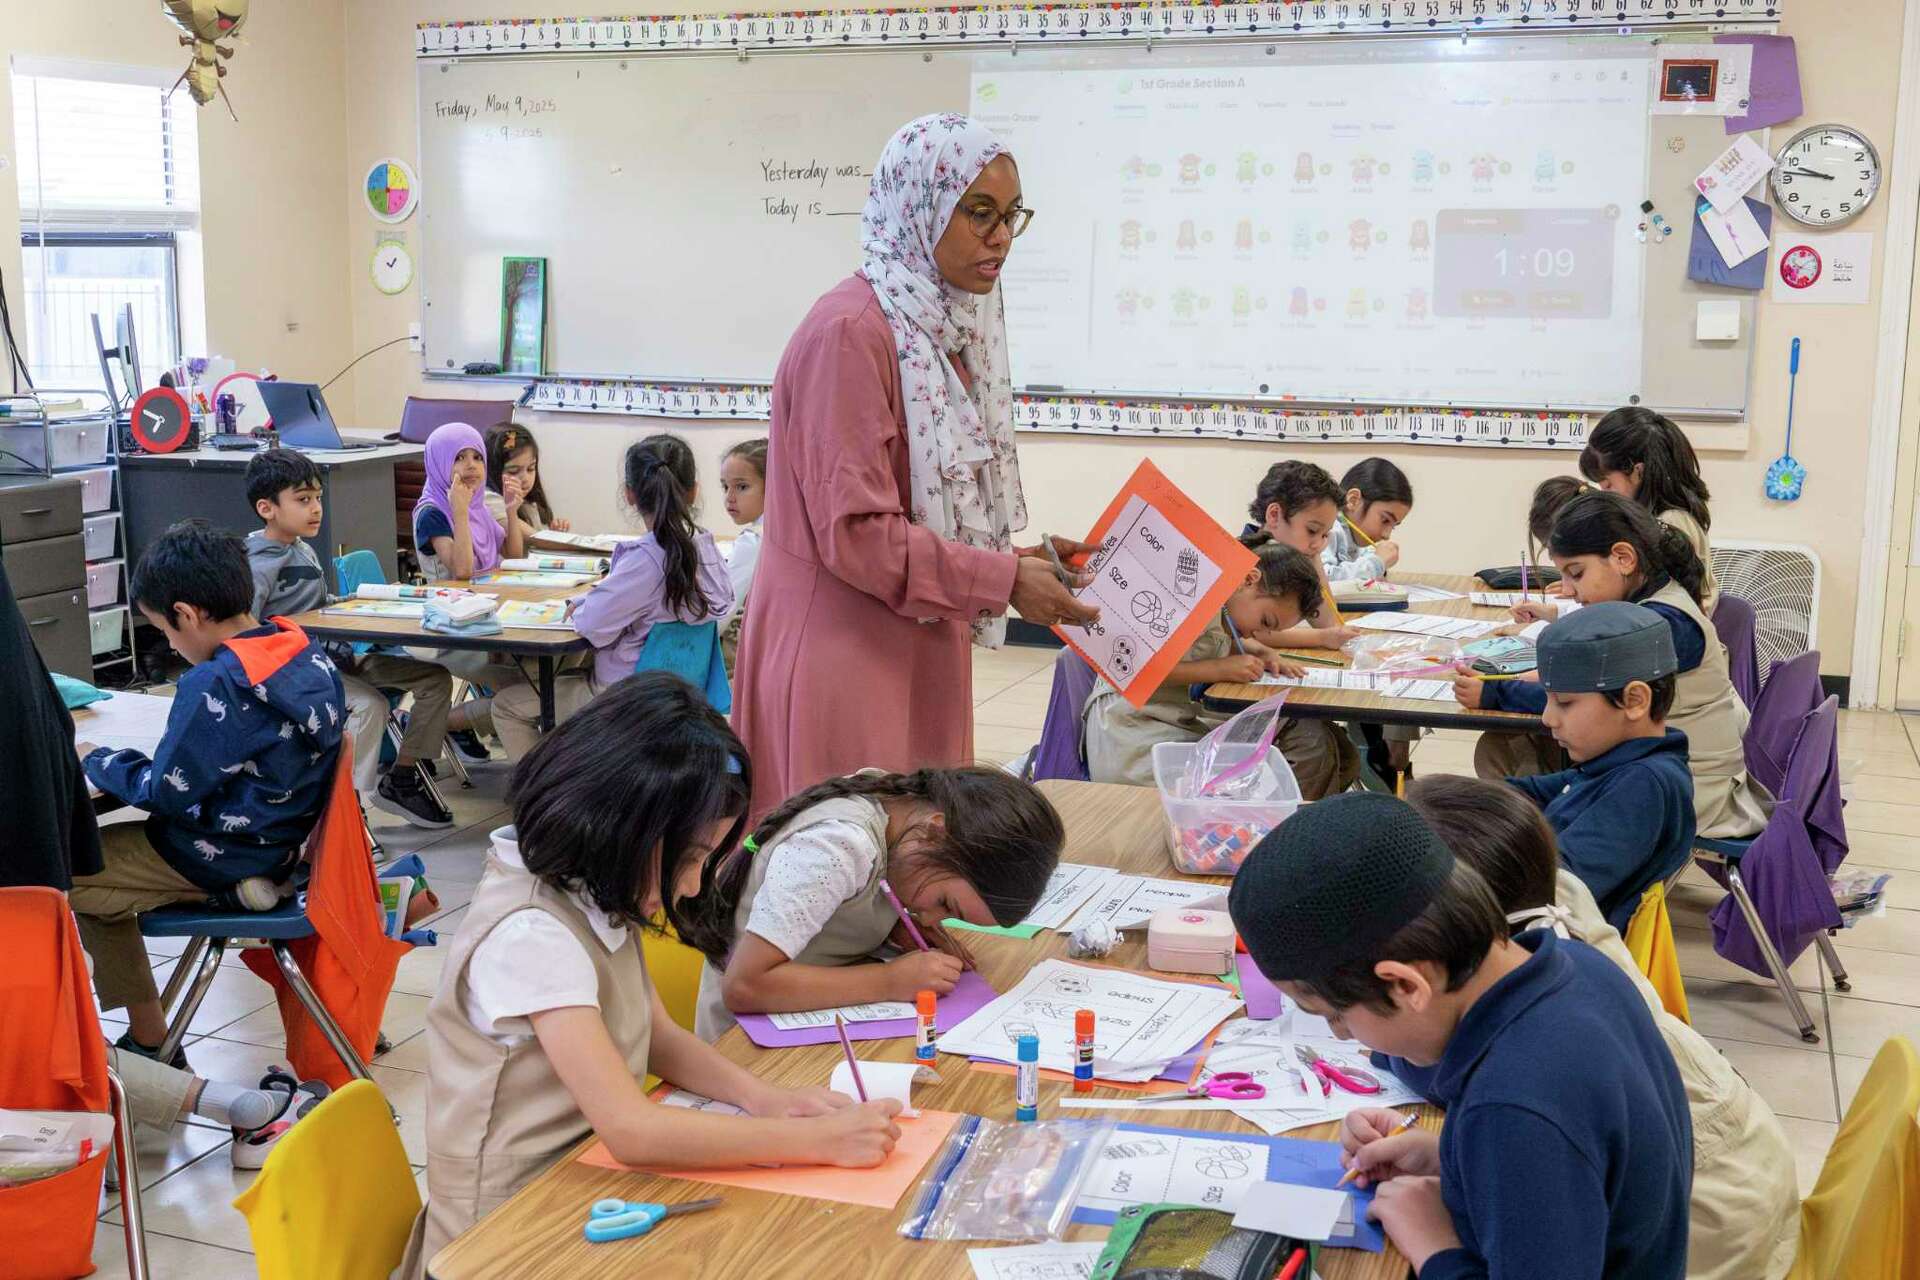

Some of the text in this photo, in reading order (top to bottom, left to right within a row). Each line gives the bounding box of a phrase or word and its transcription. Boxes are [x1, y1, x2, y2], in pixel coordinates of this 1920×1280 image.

[589, 27, 596, 39] 11
[623, 25, 631, 39] 13
[642, 25, 649, 38] 14
[660, 24, 667, 38] 15
[678, 24, 685, 38] 16
[696, 23, 703, 37] 17
[713, 24, 721, 36] 18
[730, 23, 738, 36] 19
[748, 22, 756, 35] 20
[767, 21, 774, 35] 21
[785, 21, 794, 34] 22
[804, 20, 814, 34] 23
[823, 19, 832, 33] 24
[841, 19, 852, 32] 25
[861, 18, 871, 32] 26
[881, 18, 889, 31] 27
[900, 18, 909, 31] 28
[918, 17, 928, 30] 29
[938, 16, 948, 30] 30
[959, 15, 967, 29] 31
[978, 15, 988, 29] 32
[998, 14, 1008, 28] 33
[1019, 14, 1028, 28] 34
[1038, 14, 1048, 27] 35
[1058, 13, 1069, 27] 36
[1080, 13, 1089, 28] 37
[1099, 12, 1110, 27] 38
[1120, 12, 1131, 26] 39
[1141, 12, 1152, 26] 40
[1162, 11, 1171, 25] 41
[1183, 10, 1194, 24] 42
[1203, 10, 1215, 24] 43
[1225, 9, 1236, 23] 44
[1247, 8, 1258, 22] 45
[1268, 7, 1280, 21] 46
[1291, 6, 1302, 20] 47
[1313, 6, 1325, 19] 48
[1336, 5, 1348, 19] 49
[1359, 4, 1370, 18] 50
[1382, 3, 1390, 17] 51
[1404, 2, 1415, 16] 52
[1427, 1, 1438, 16] 53
[1450, 0, 1462, 15] 54
[1473, 0, 1485, 14] 55
[1497, 0, 1509, 13] 56
[1521, 0, 1531, 12] 57
[1544, 0, 1556, 12] 58
[1568, 0, 1580, 11] 59
[1592, 0, 1604, 11] 60
[1156, 79, 1192, 90] Grade
[1193, 78, 1235, 89] Section
[435, 100, 477, 121] Friday,
[485, 94, 509, 114] May
[528, 100, 557, 113] 2025
[1803, 143, 1811, 152] 11
[1788, 157, 1799, 167] 10
[1854, 152, 1865, 162] 2
[761, 159, 861, 188] Yesterday was
[1860, 170, 1871, 180] 3
[1783, 175, 1793, 185] 9
[1788, 192, 1799, 202] 8
[1854, 188, 1865, 197] 4
[761, 197, 822, 224] Today is
[1802, 205, 1811, 215] 7
[1840, 202, 1851, 212] 5
[1820, 209, 1831, 218] 6
[1495, 247, 1574, 277] 1:09
[539, 386, 548, 399] 68
[556, 387, 565, 400] 69
[590, 388, 597, 401] 71
[625, 390, 633, 402] 73
[642, 390, 650, 404] 74
[658, 392, 667, 405] 75
[674, 394, 682, 407] 76
[692, 395, 699, 407] 77
[710, 394, 718, 407] 78
[728, 393, 736, 407] 79
[746, 393, 756, 406] 80
[1029, 406, 1040, 419] 95
[1050, 407, 1060, 420] 96
[1071, 407, 1080, 420] 97
[1090, 408, 1101, 421] 98
[1109, 410, 1120, 422] 99
[1129, 410, 1141, 424] 100
[1150, 412, 1161, 424] 101
[1170, 412, 1182, 425] 102
[1191, 412, 1204, 425] 103
[1213, 412, 1226, 426] 104
[1234, 414, 1246, 428] 105
[1254, 414, 1267, 429] 106
[1275, 415, 1287, 431] 107
[1296, 418, 1309, 432] 108
[1318, 418, 1331, 432] 109
[1341, 416, 1354, 432] 110
[1364, 418, 1374, 432] 111
[1385, 417, 1397, 430] 112
[1410, 416, 1422, 430] 113
[1432, 418, 1444, 432] 114
[1455, 418, 1466, 433] 115
[1477, 418, 1489, 434] 116
[1500, 420, 1512, 435] 117
[1523, 422, 1535, 436] 118
[1546, 420, 1559, 436] 119
[1570, 420, 1583, 436] 120
[1140, 526, 1165, 553] Color
[1109, 566, 1128, 590] Size
